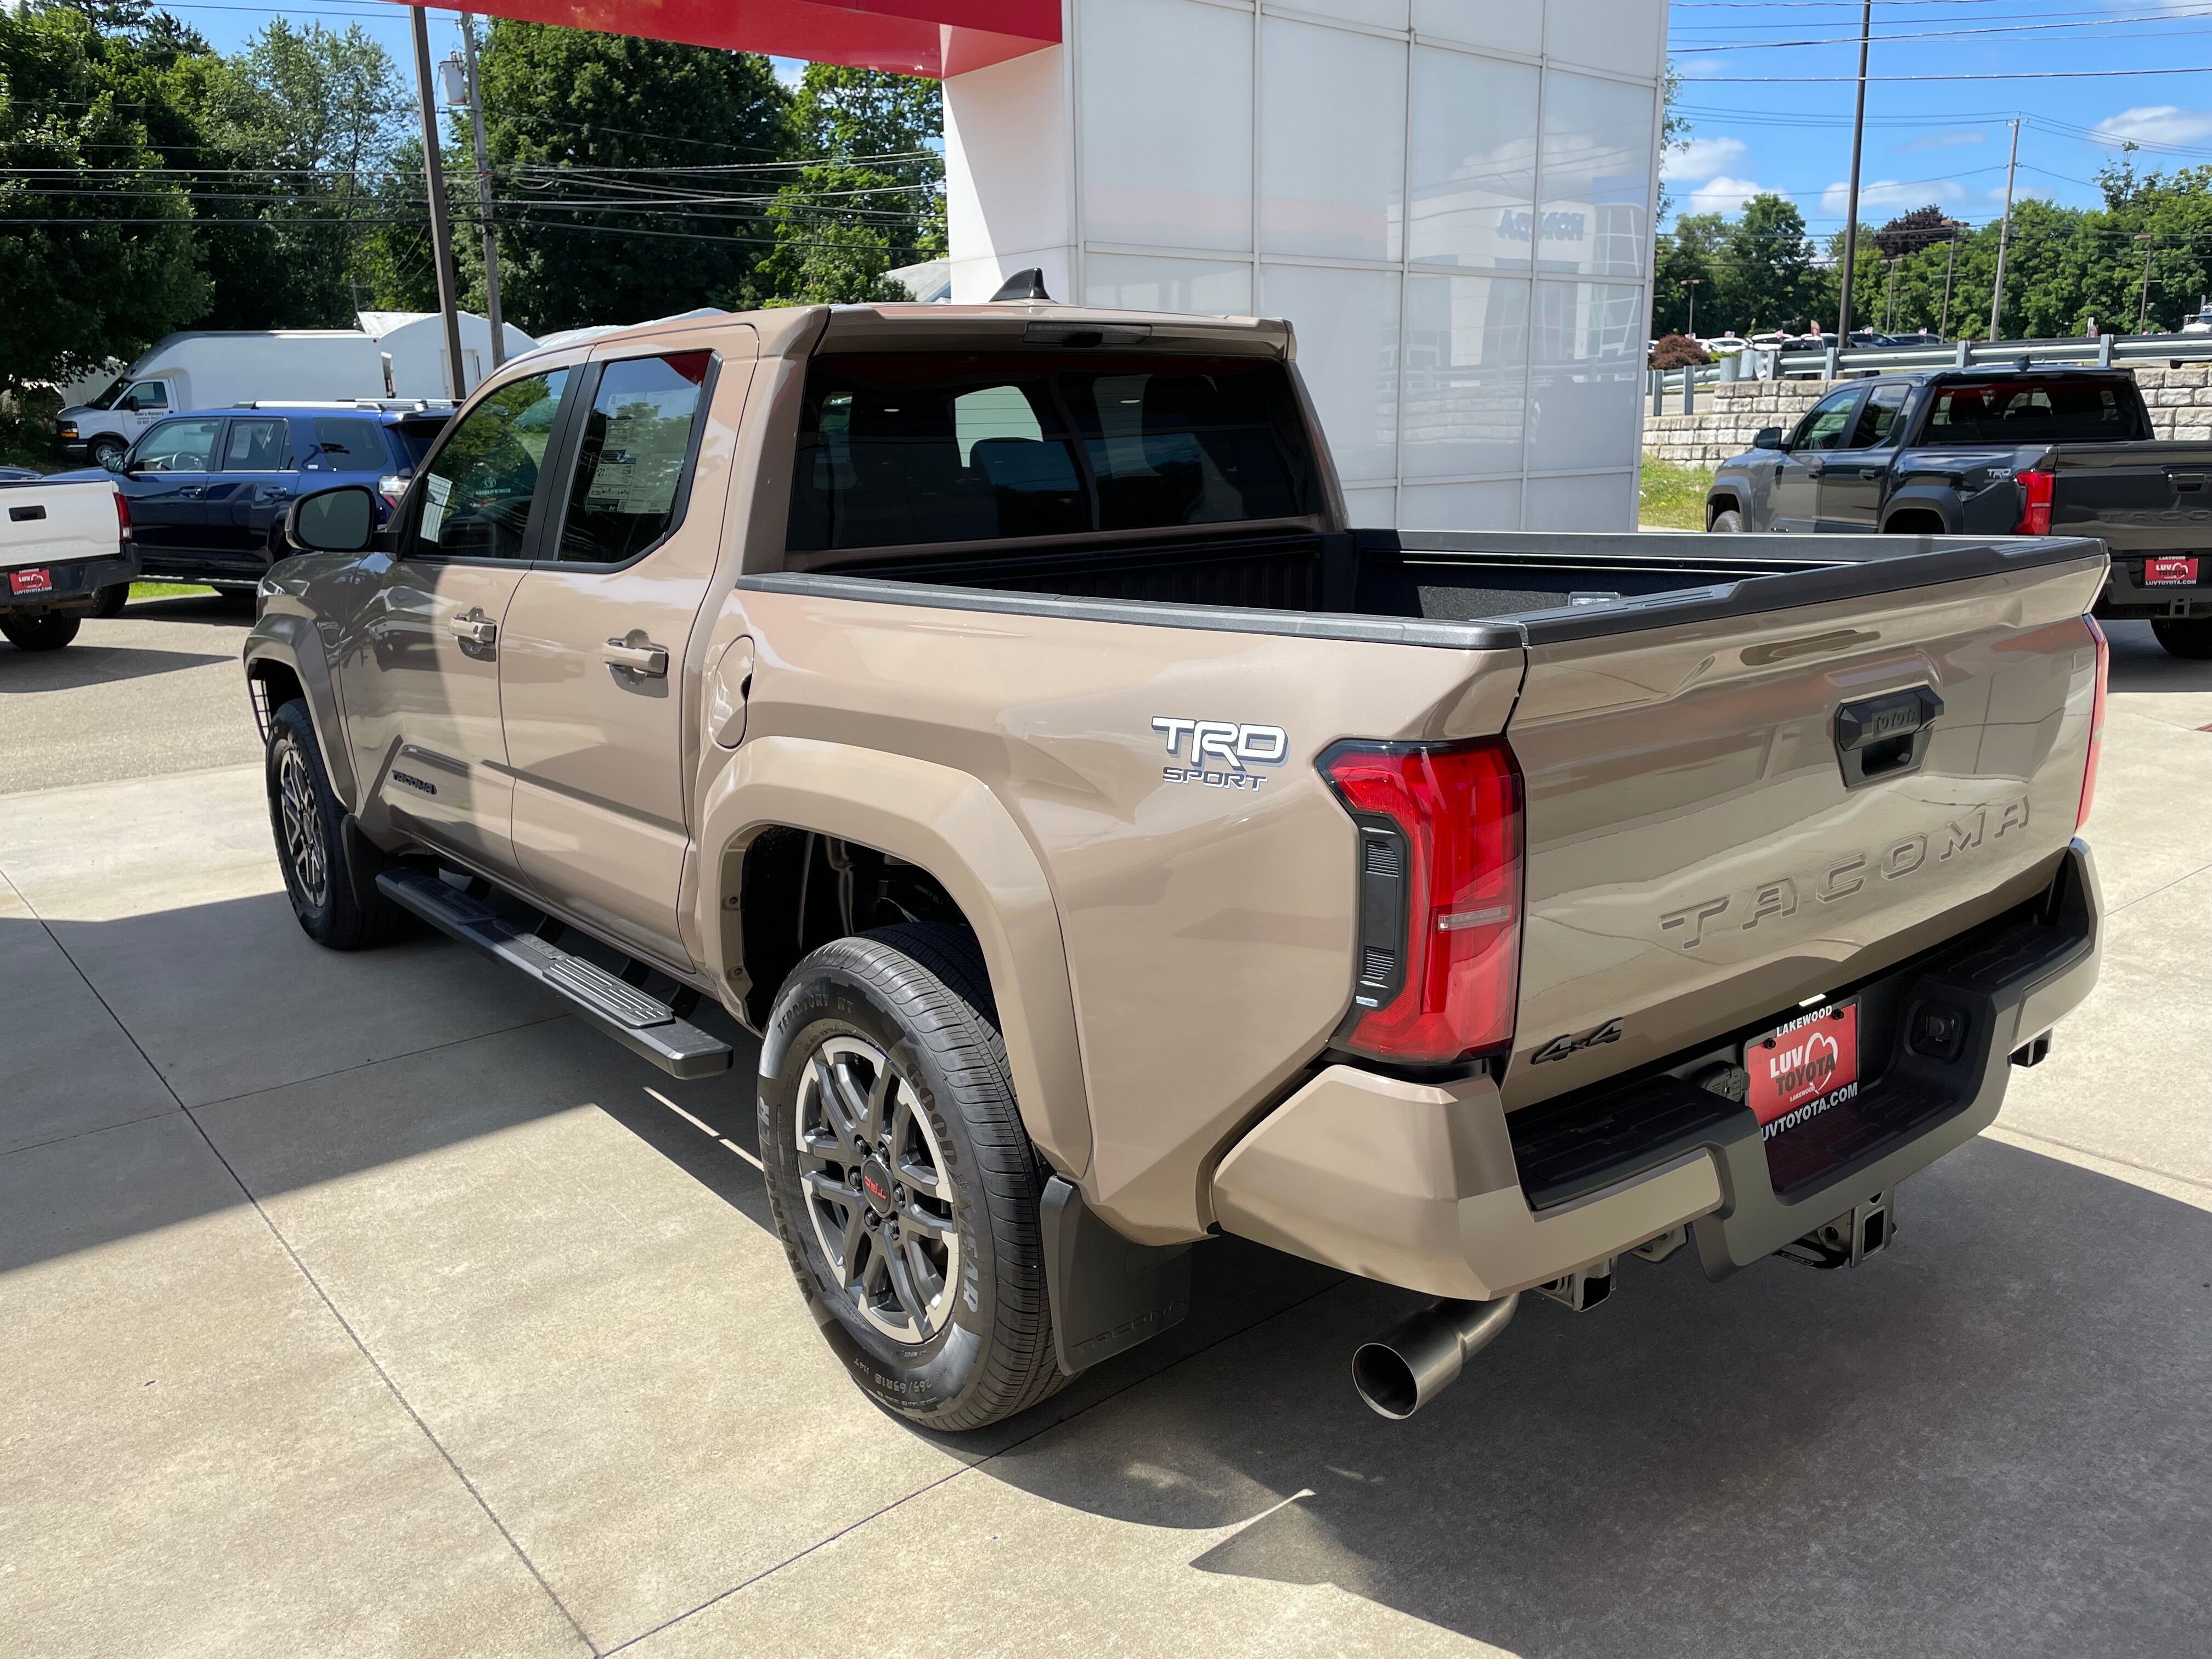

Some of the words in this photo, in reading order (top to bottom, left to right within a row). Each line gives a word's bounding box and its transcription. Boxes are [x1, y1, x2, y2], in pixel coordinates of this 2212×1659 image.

[1987, 468, 2012, 478] TRD
[14, 586, 52, 595] LUVTOYOTA.COM
[1874, 707, 1919, 731] TOYOTA
[1152, 716, 1290, 773] TRD
[392, 770, 437, 795] TACOMA
[1163, 766, 1269, 792] SPORT
[1658, 794, 2030, 950] TACOMA
[777, 993, 830, 1036] TERRITORY
[1776, 1005, 1833, 1038] LAKEWOOD
[1770, 1045, 1804, 1079] LUV
[1775, 1053, 1836, 1097] TOYOTA
[1790, 1085, 1816, 1102] LAKEWOOD
[1760, 1081, 1858, 1142] UVTOYOTA.COM
[759, 1095, 815, 1306] WRANGLER
[864, 1175, 887, 1200] TRD
